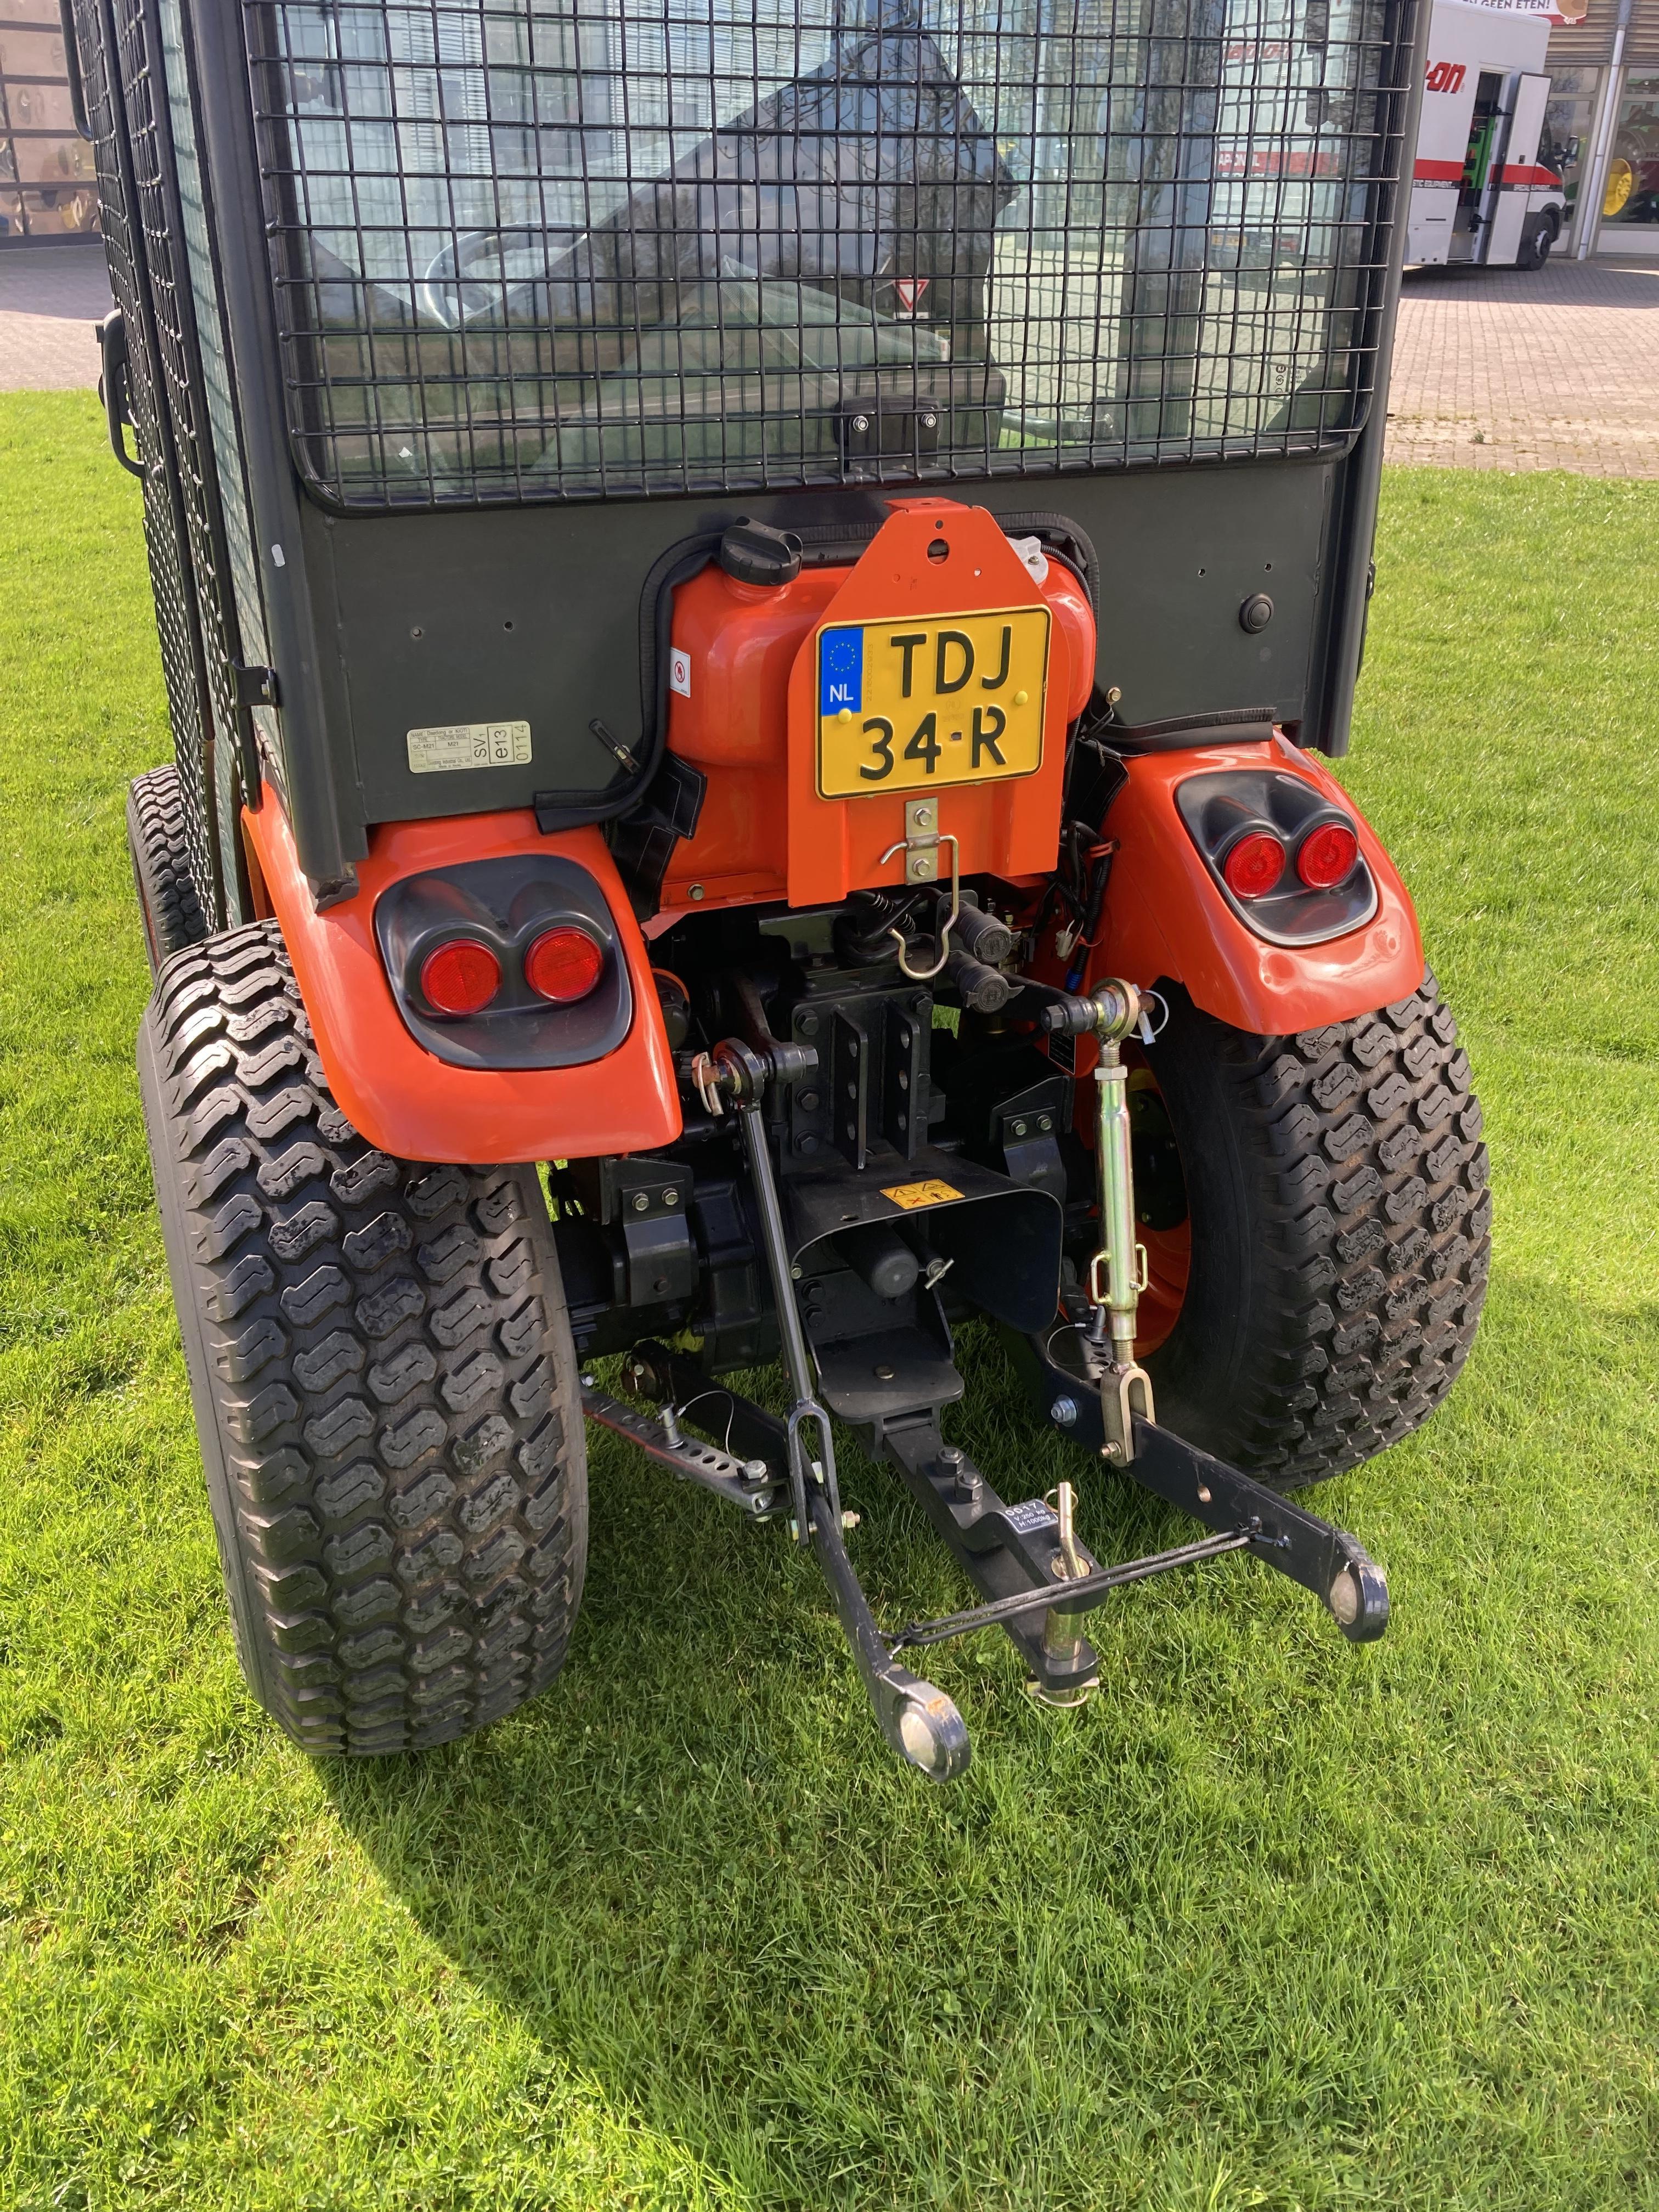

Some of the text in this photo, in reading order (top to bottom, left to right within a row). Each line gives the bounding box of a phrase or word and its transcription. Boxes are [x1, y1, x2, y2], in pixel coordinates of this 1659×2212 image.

[891, 626, 1011, 698] TDJ
[830, 684, 854, 702] NL
[494, 730, 509, 758] e13
[515, 725, 529, 761] 0114
[860, 706, 1006, 780] 34-R
